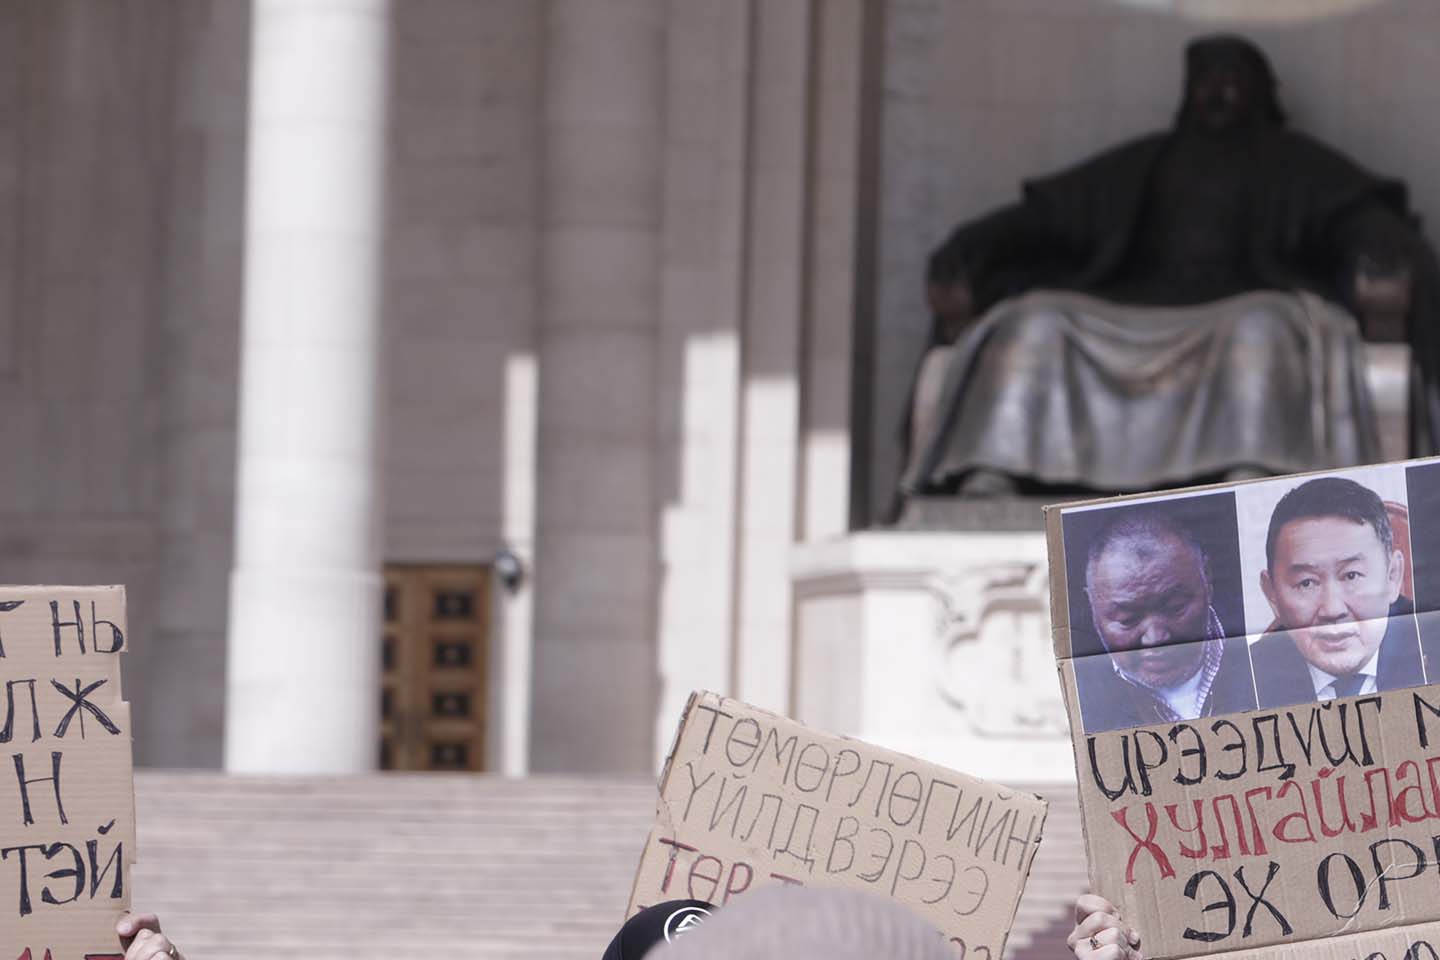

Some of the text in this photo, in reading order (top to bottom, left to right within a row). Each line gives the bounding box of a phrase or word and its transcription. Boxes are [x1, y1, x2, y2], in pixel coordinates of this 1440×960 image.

[49, 599, 124, 657] НЬ
[682, 762, 990, 916] ҮЙЛДВЭРЭЭ
[697, 705, 1037, 871] ТӨМӨРЛӨГИЙН
[1182, 861, 1293, 943] ЭХ
